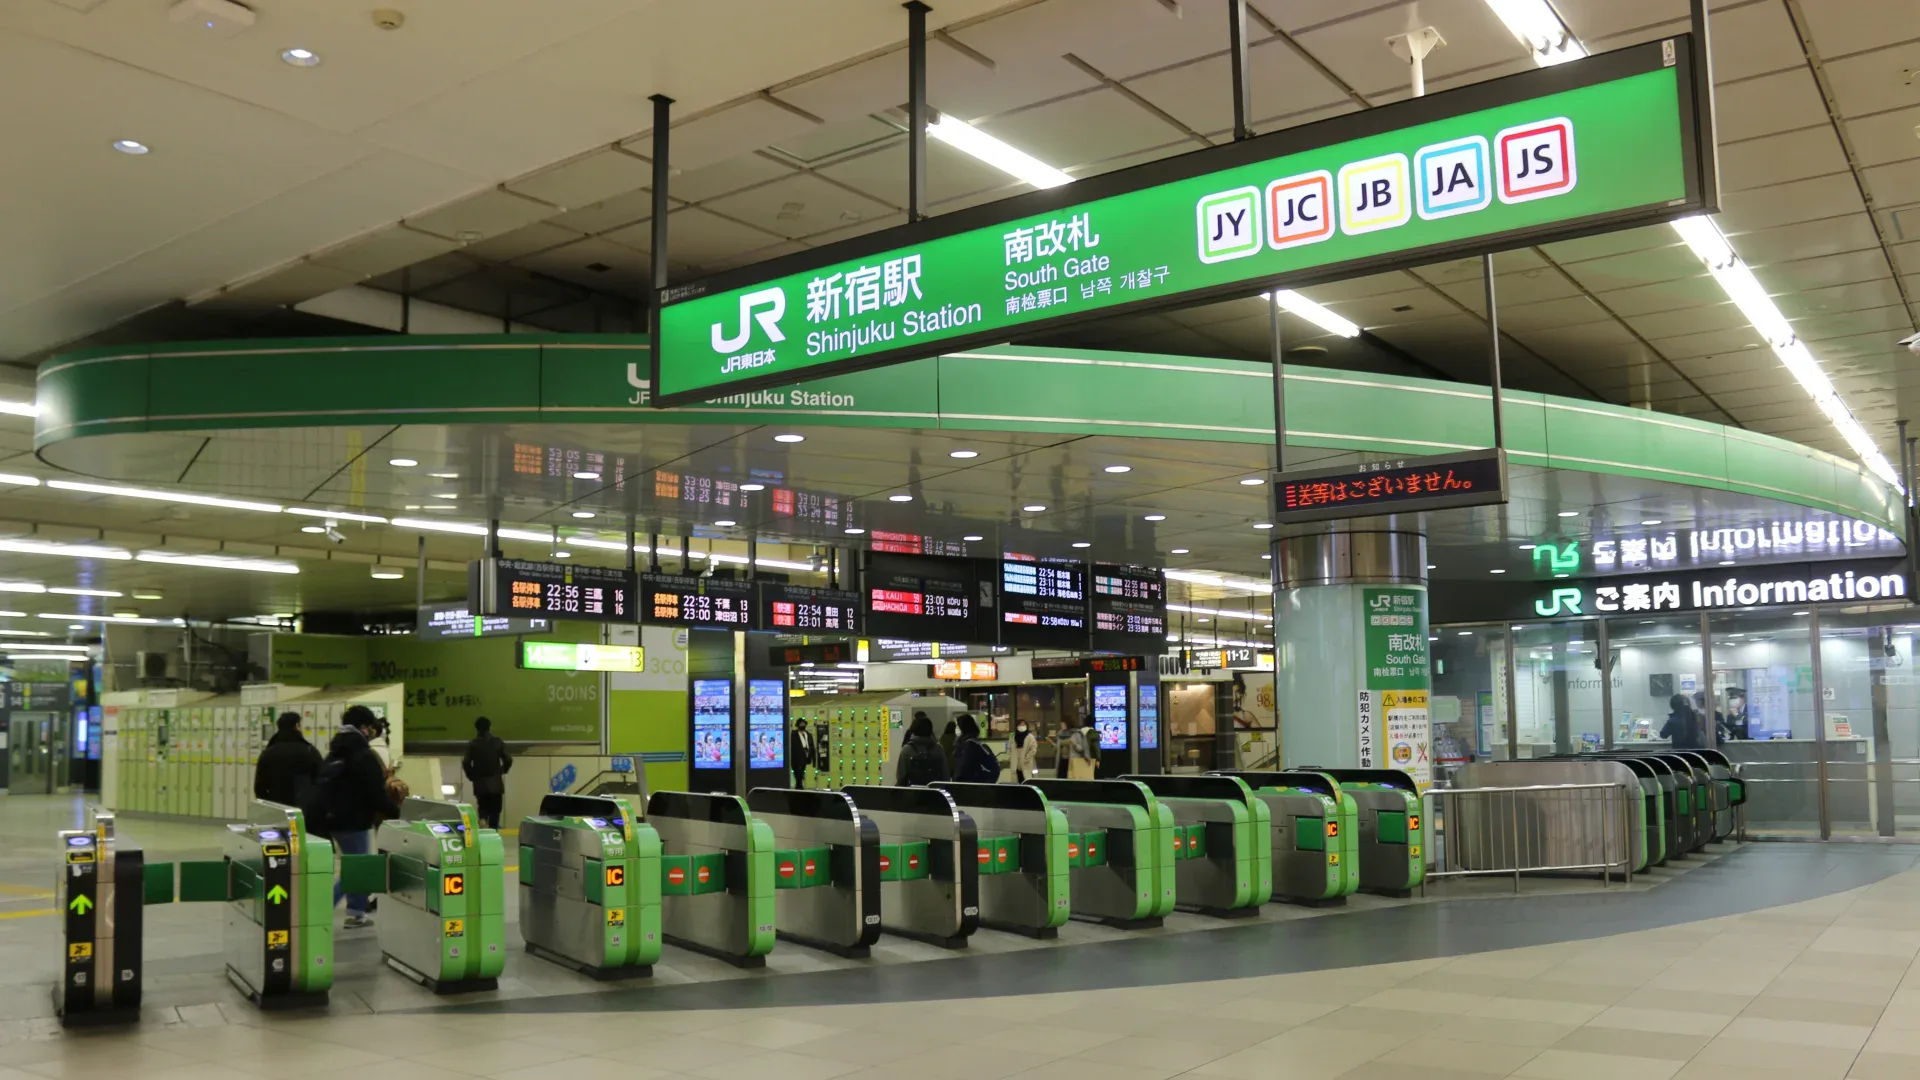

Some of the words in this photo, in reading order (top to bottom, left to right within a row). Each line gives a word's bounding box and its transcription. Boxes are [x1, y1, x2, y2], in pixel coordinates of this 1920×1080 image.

[1212, 207, 1247, 241] JY
[1283, 193, 1318, 227] JC
[1356, 177, 1393, 211] JB
[1432, 161, 1475, 197] JA
[1516, 143, 1554, 180] JS
[1003, 212, 1100, 266] 南改札
[1004, 262, 1059, 292] South
[1063, 253, 1111, 279] Gate
[806, 253, 923, 325] 新宿駅
[1005, 290, 1068, 315] 南检票口
[1080, 275, 1113, 301] 남쪽
[1119, 265, 1172, 291] 개찰구
[710, 286, 787, 354] JR
[806, 322, 896, 360] Shinjuku
[902, 299, 982, 338] Station
[721, 348, 777, 374] JR東日本
[790, 389, 854, 407] Station
[1358, 460, 1405, 473] お知らせ
[1286, 469, 1473, 508] 送等はございません。
[1038, 567, 1055, 578] 22:54
[1038, 577, 1055, 588] 23:11
[1692, 570, 1905, 608] Information
[547, 584, 579, 598] 22:56
[615, 590, 624, 602] 16
[925, 594, 945, 606] 23:00
[1038, 587, 1056, 597] 23:14
[1393, 595, 1415, 606] 新宿駅
[1595, 581, 1681, 612] ご案内
[547, 598, 579, 612] 23:02
[615, 603, 624, 615] 16
[683, 595, 710, 608] 22:52
[715, 598, 730, 609] 千葉
[741, 600, 749, 611] 13
[1370, 594, 1391, 608] JR
[1535, 587, 1582, 617] JR
[683, 608, 711, 621] 23:00
[715, 611, 737, 622] 津田沼
[741, 612, 749, 623] 13
[798, 604, 821, 616] 22:54
[846, 608, 854, 618] 12
[914, 605, 920, 614] 9
[925, 605, 945, 617] 23:15
[963, 609, 968, 619] 9
[798, 616, 821, 628] 23:01
[825, 618, 839, 628] 高尾
[846, 619, 854, 630] 12
[1388, 634, 1425, 651] 南改札
[628, 651, 642, 668] 13
[1386, 654, 1411, 664] South
[548, 684, 597, 701] 3COINS
[1359, 692, 1371, 768] 防犯カメラ作動
[1321, 796, 1335, 806] IC
[1402, 791, 1417, 801] IC
[1328, 823, 1338, 836] IC
[1409, 816, 1419, 830] IC
[441, 838, 463, 852] IC
[602, 832, 623, 845] IC
[445, 876, 463, 893] IC
[607, 868, 623, 885] IC
